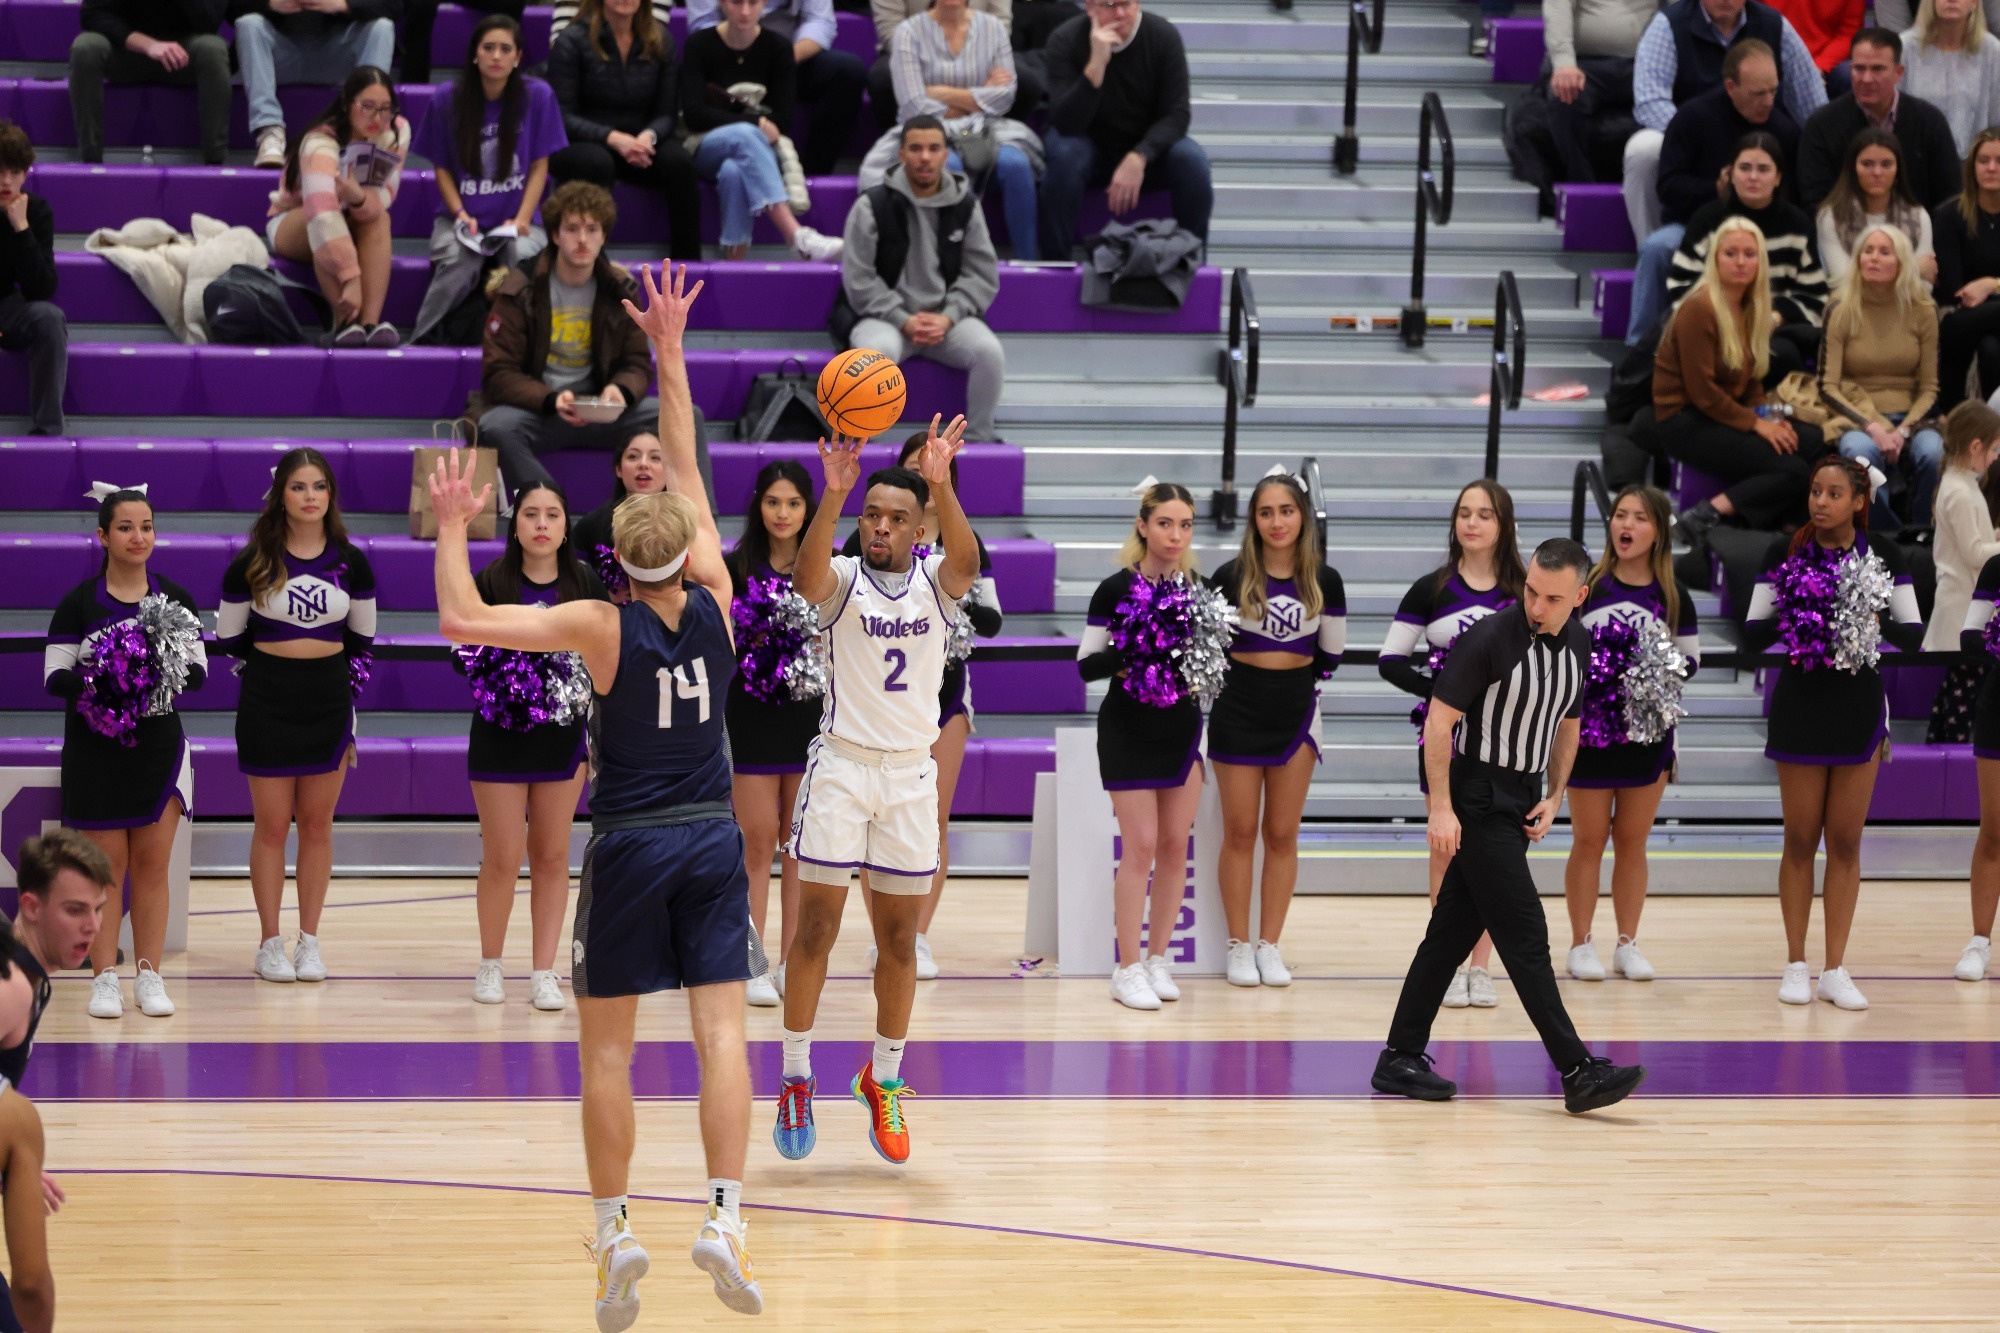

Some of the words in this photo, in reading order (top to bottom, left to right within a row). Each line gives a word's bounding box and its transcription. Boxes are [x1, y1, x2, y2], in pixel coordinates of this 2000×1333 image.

[479, 175, 525, 195] BACK
[859, 614, 930, 639] Violets
[884, 648, 908, 692] 2
[655, 656, 711, 729] 14
